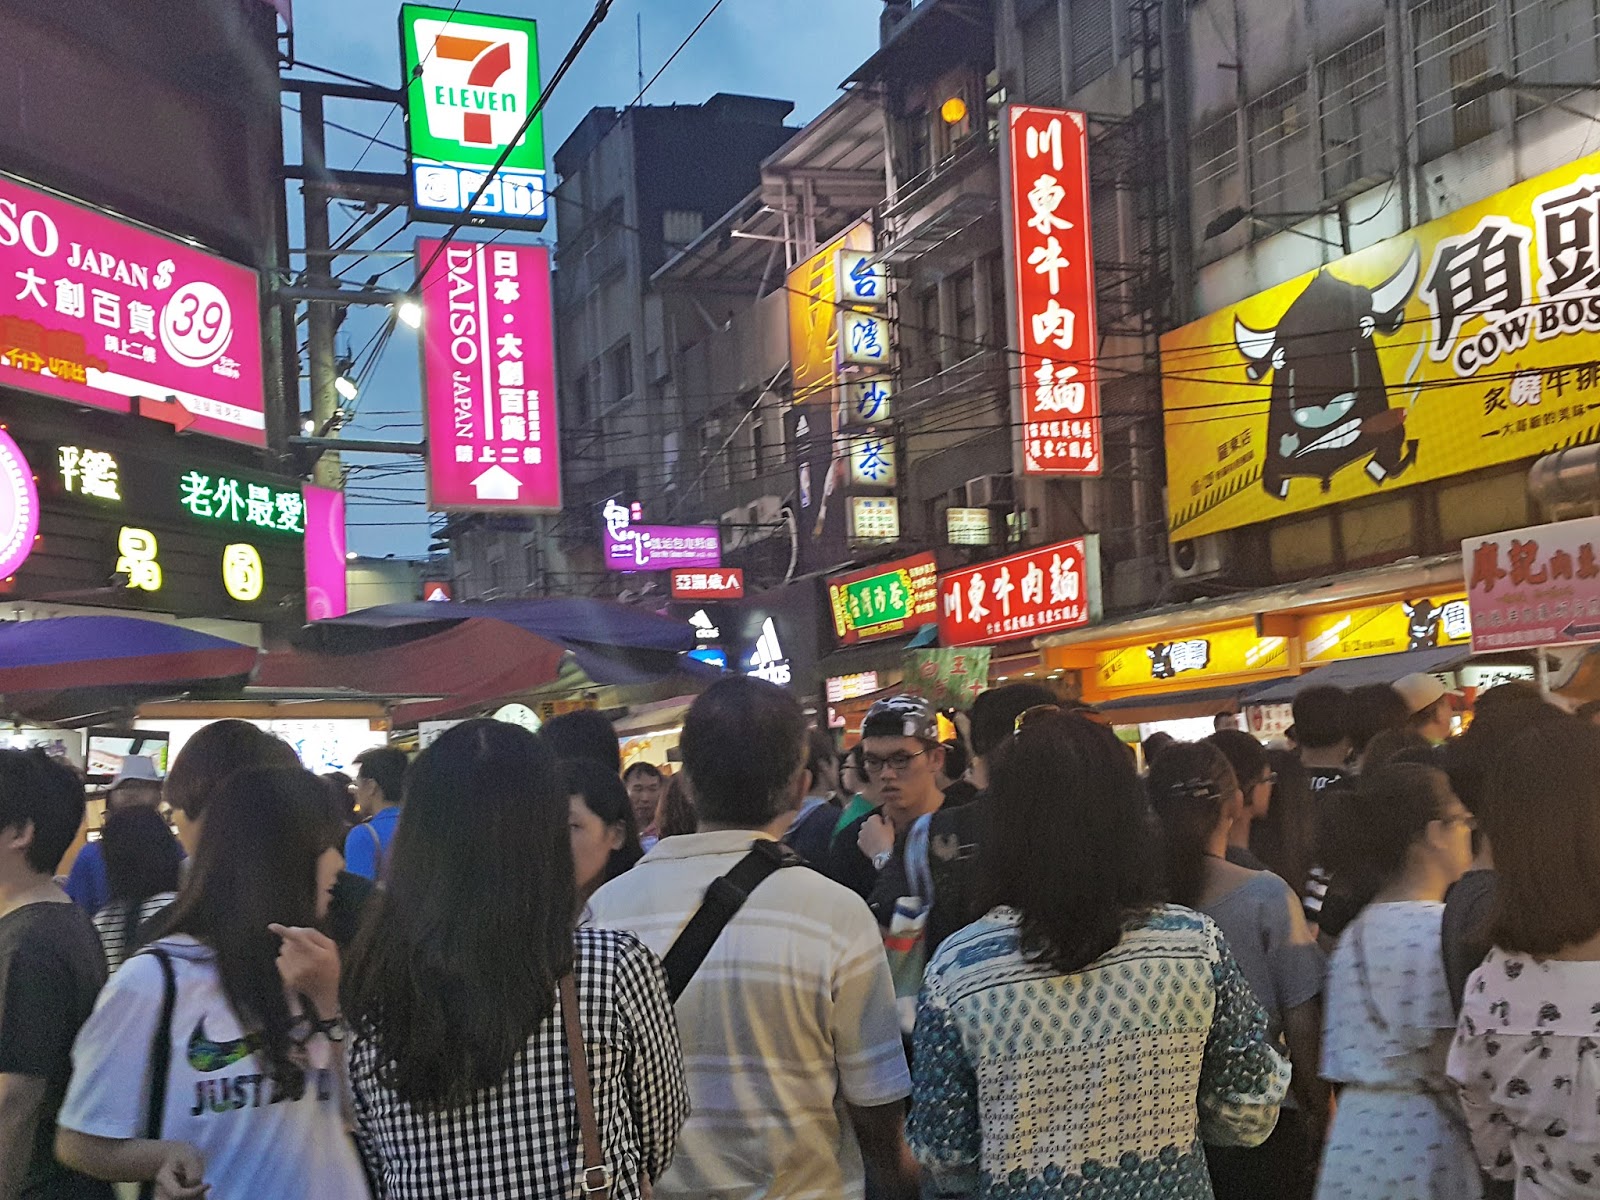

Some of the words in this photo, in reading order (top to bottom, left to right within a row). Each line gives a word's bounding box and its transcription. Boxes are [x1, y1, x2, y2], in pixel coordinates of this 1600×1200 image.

[435, 34, 511, 144] 7
[67, 242, 149, 290] JAPAN
[1026, 118, 1085, 413] 川東牛肉麵
[15, 267, 157, 341] 大創百貨
[172, 292, 224, 345] 39
[447, 247, 478, 365] DAISO
[1458, 313, 1529, 371] COW
[452, 370, 474, 439] JAPAN
[180, 470, 304, 533] 老外最愛
[944, 553, 1079, 623] 川東牛肉麵
[191, 1073, 262, 1116] JUST
